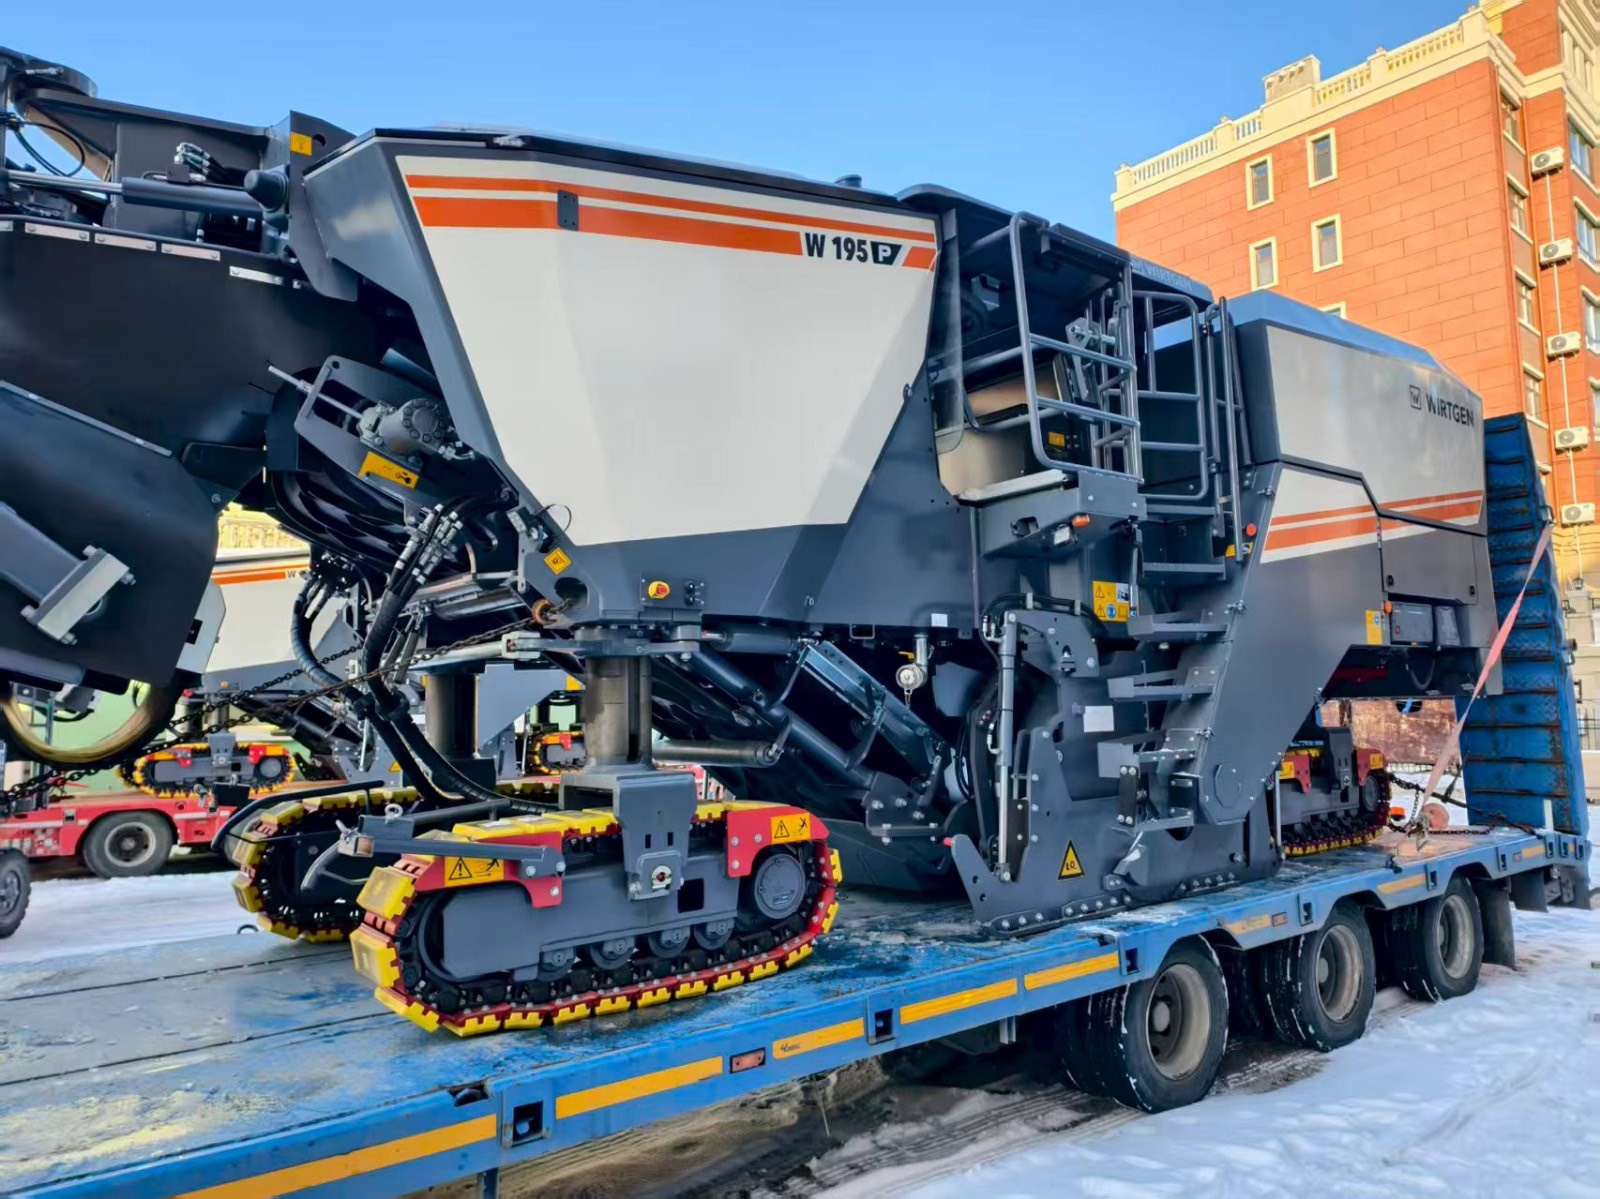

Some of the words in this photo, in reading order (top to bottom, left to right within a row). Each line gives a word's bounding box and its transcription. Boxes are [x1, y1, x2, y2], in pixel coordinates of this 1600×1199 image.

[805, 232, 825, 258] W
[832, 236, 868, 263] 195
[1426, 393, 1474, 427] WIRTGEN
